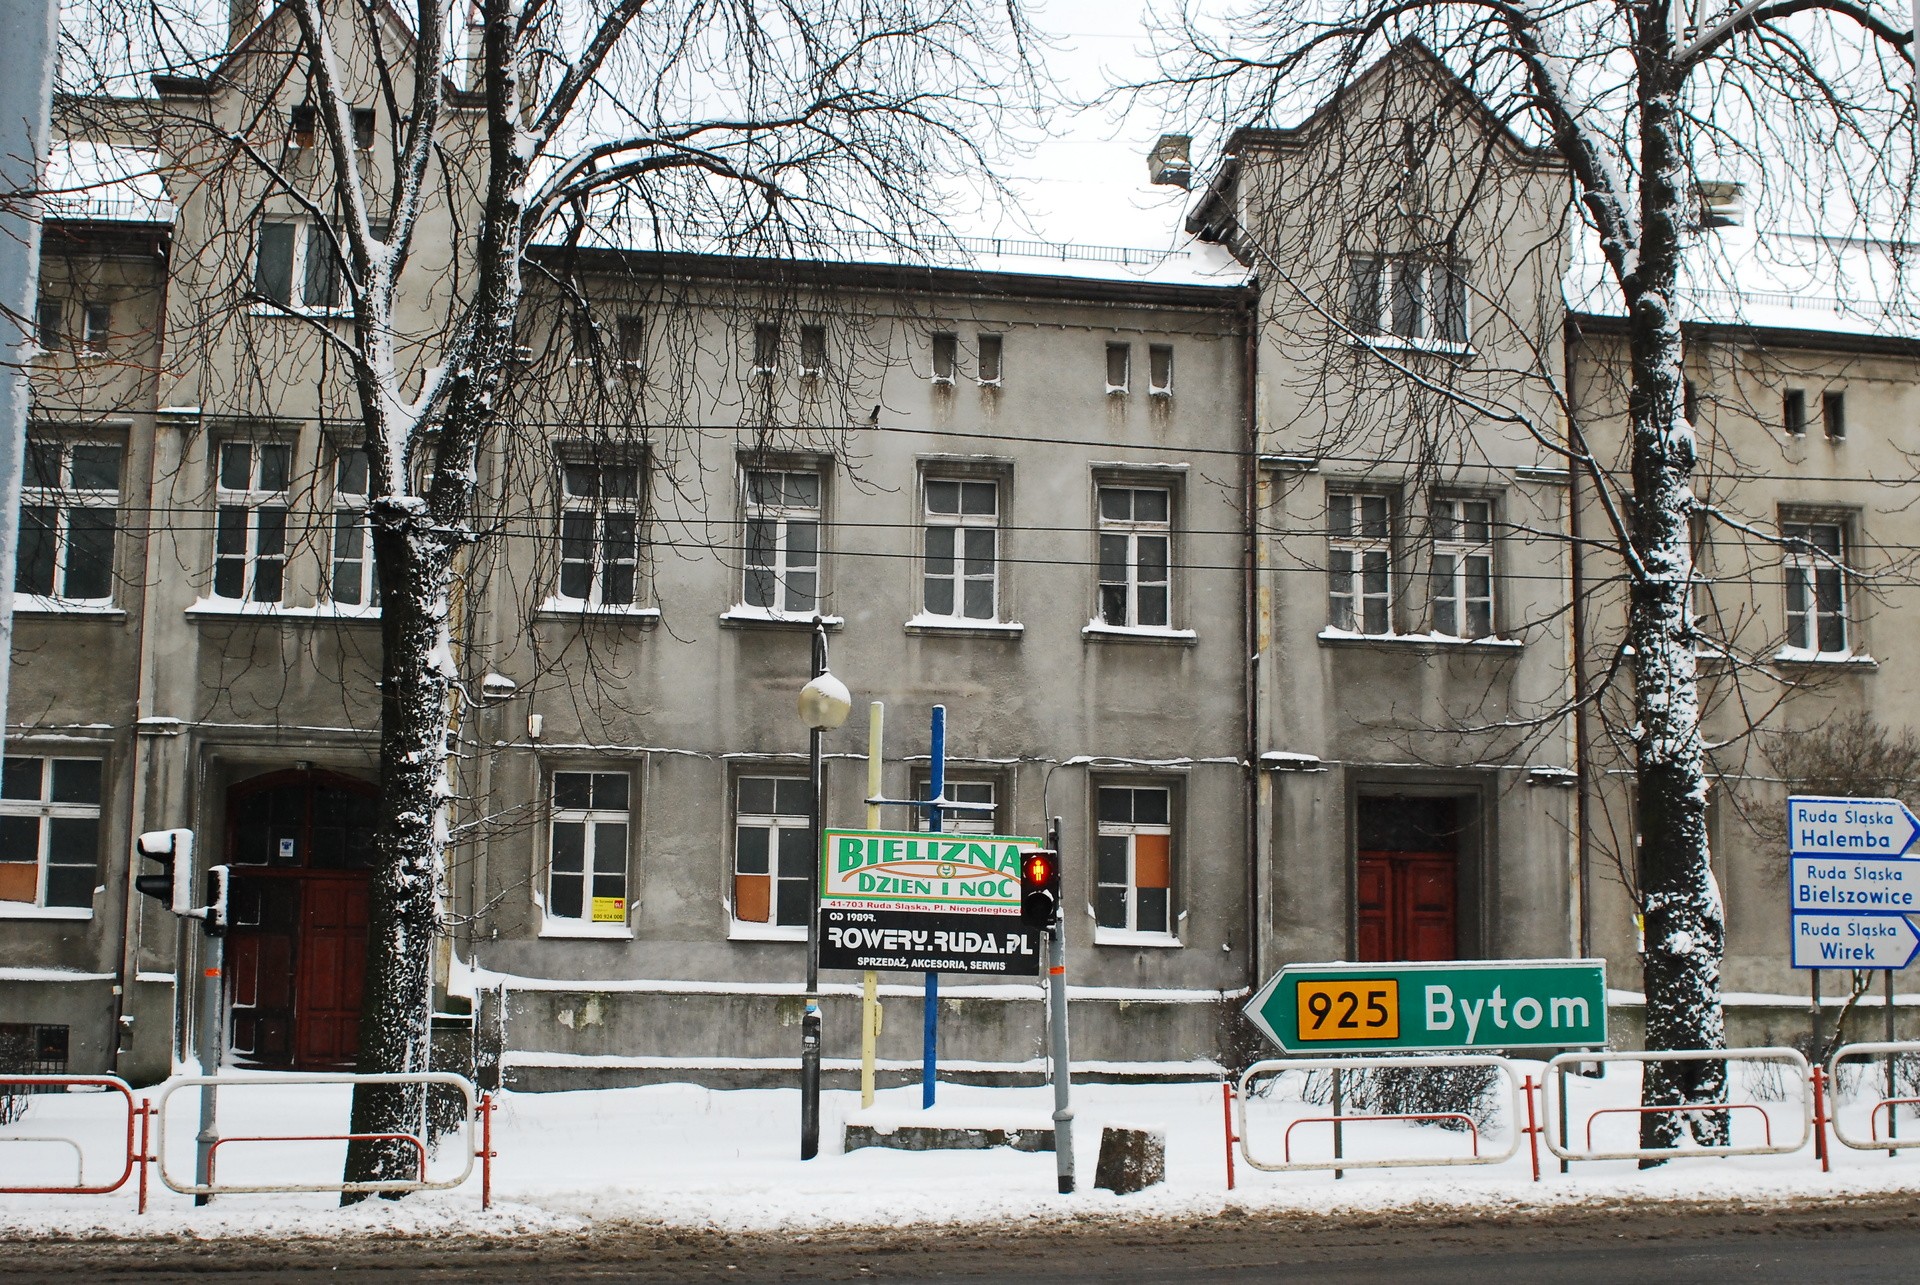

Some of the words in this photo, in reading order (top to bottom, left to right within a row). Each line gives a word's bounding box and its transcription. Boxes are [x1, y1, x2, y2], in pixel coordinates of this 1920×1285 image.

[1799, 809, 1837, 824] Ruda
[1802, 829, 1890, 848] Halemba
[838, 837, 1021, 878] BIELIZNA
[1807, 865, 1846, 880] Ruda
[942, 882, 949, 896] I
[960, 879, 1013, 898] NOC
[1799, 885, 1913, 905] Bielszowice
[830, 900, 863, 908] 41-703
[829, 912, 844, 921] OD
[1801, 922, 1840, 936] Ruda
[828, 927, 1034, 955] ROWERY.RUDA.PL
[1820, 942, 1875, 960] Wirek
[857, 956, 909, 969] SPRZEDAŻ,
[911, 958, 968, 971] AKCESORIA,
[970, 960, 1006, 971] SERWIS
[1307, 990, 1389, 1030] 925
[1425, 984, 1590, 1045] Bytom
